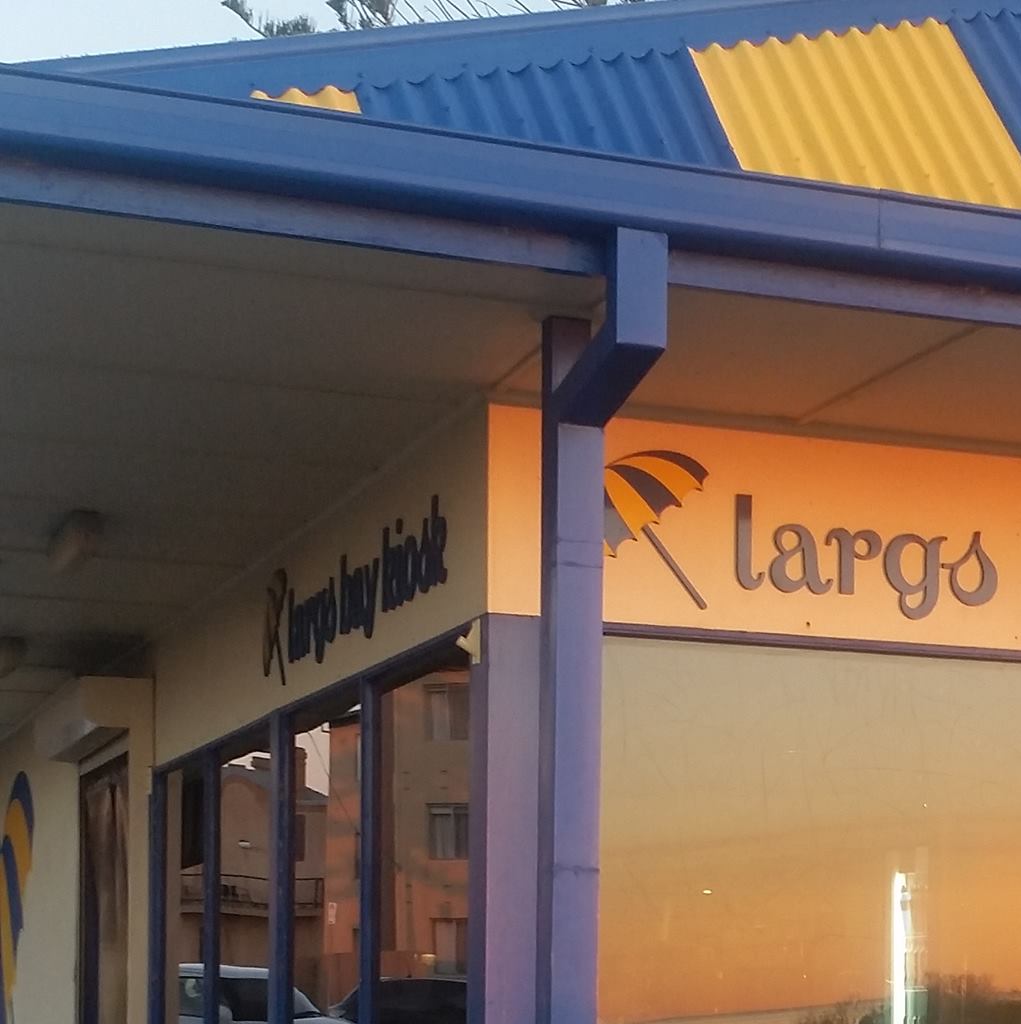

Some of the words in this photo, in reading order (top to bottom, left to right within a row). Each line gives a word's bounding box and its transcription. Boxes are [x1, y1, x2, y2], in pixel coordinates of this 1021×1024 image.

[339, 553, 379, 639] bay
[382, 494, 448, 613] kiosk
[734, 493, 999, 620] largs
